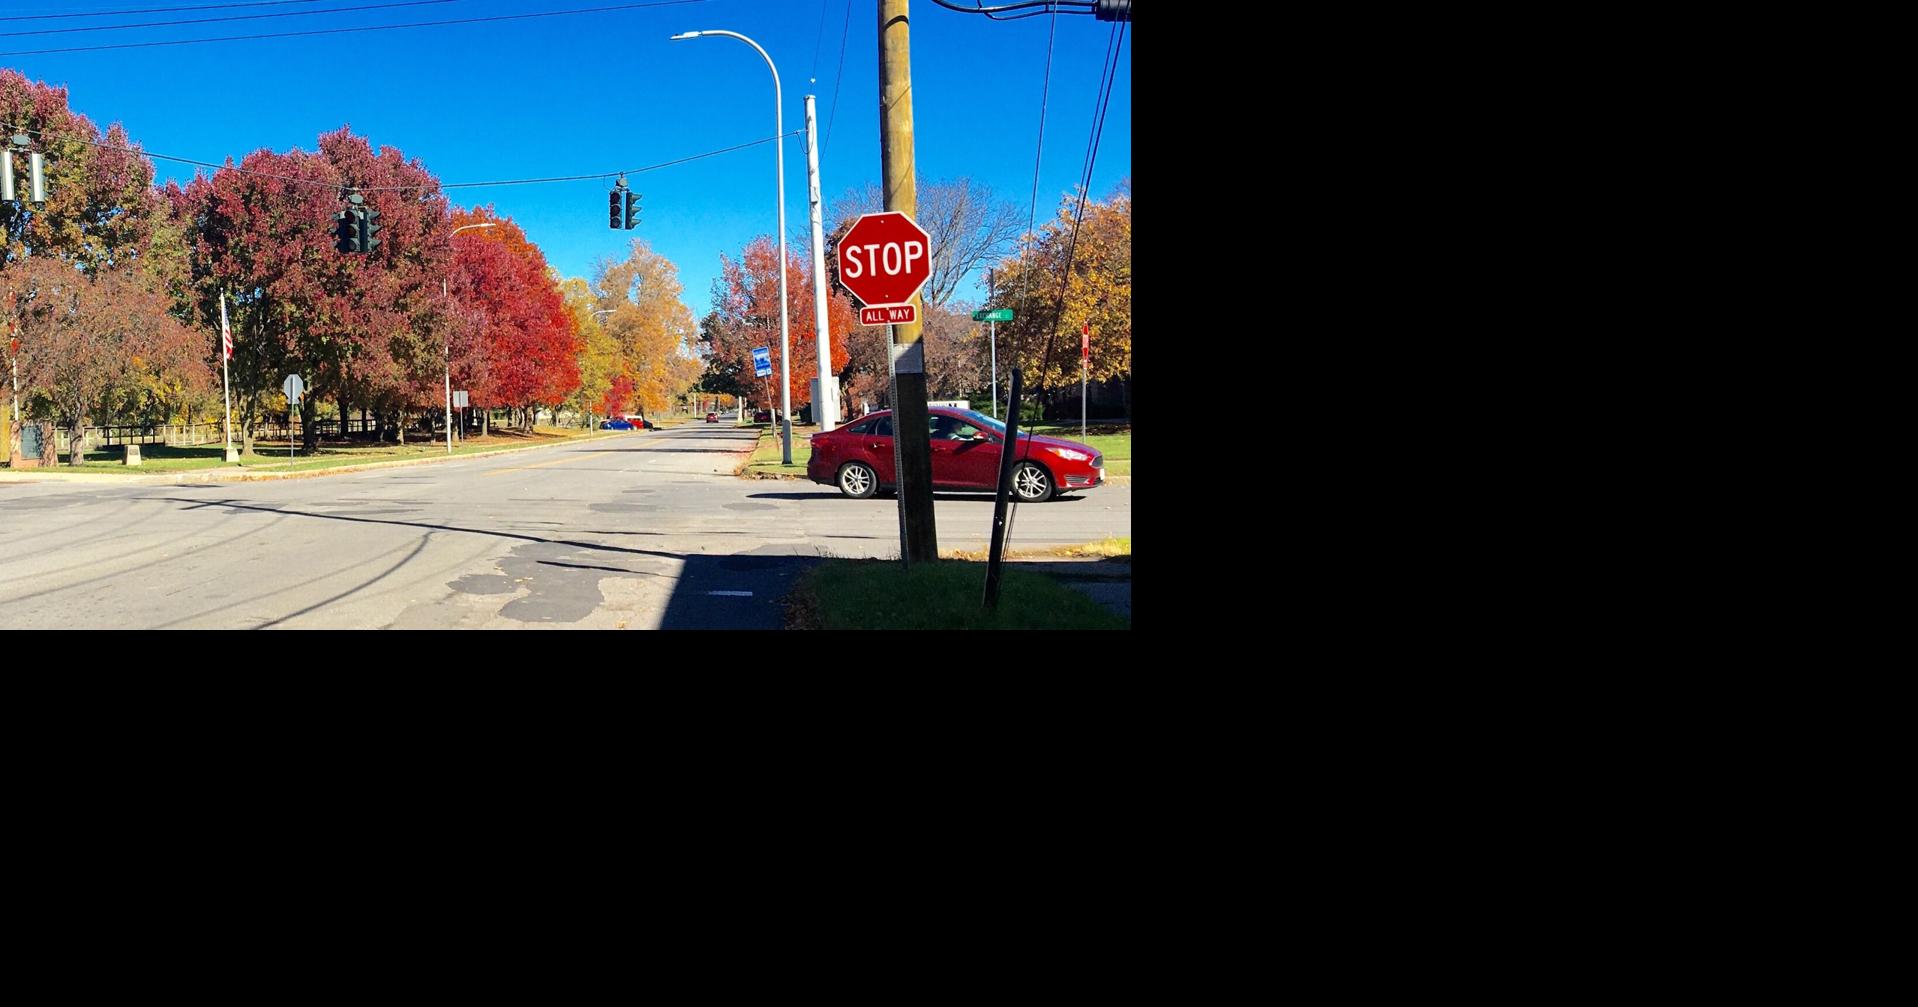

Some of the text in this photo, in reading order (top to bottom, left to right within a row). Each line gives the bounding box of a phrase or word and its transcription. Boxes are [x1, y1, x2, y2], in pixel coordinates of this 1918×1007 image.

[845, 240, 923, 279] STOP
[866, 308, 910, 322] ALL WAY
